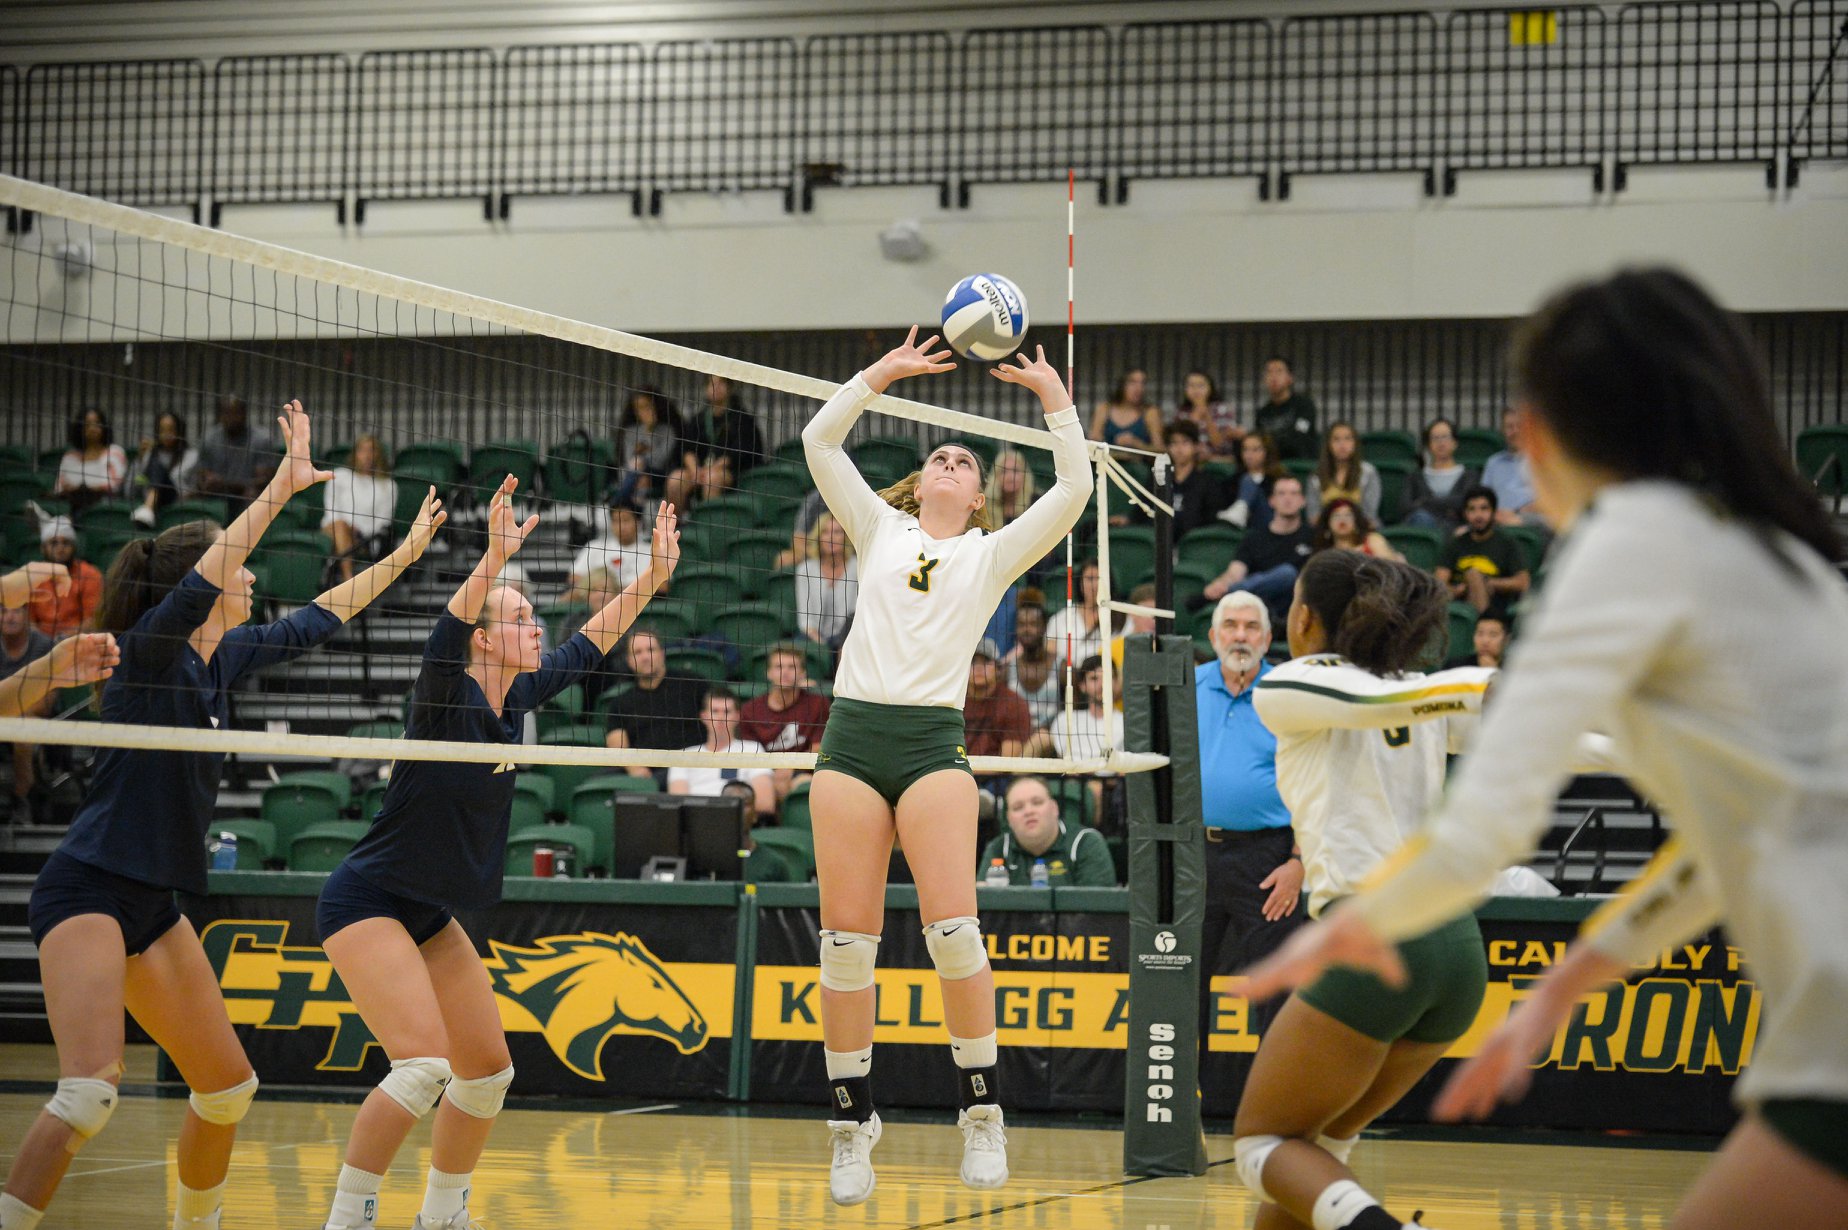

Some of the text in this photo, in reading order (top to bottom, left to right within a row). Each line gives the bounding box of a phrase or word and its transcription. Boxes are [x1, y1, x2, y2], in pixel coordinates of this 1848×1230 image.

[981, 281, 1009, 326] molten
[908, 552, 939, 594] 3
[980, 933, 1111, 961] LCOME
[779, 981, 1074, 1031] KLLGG
